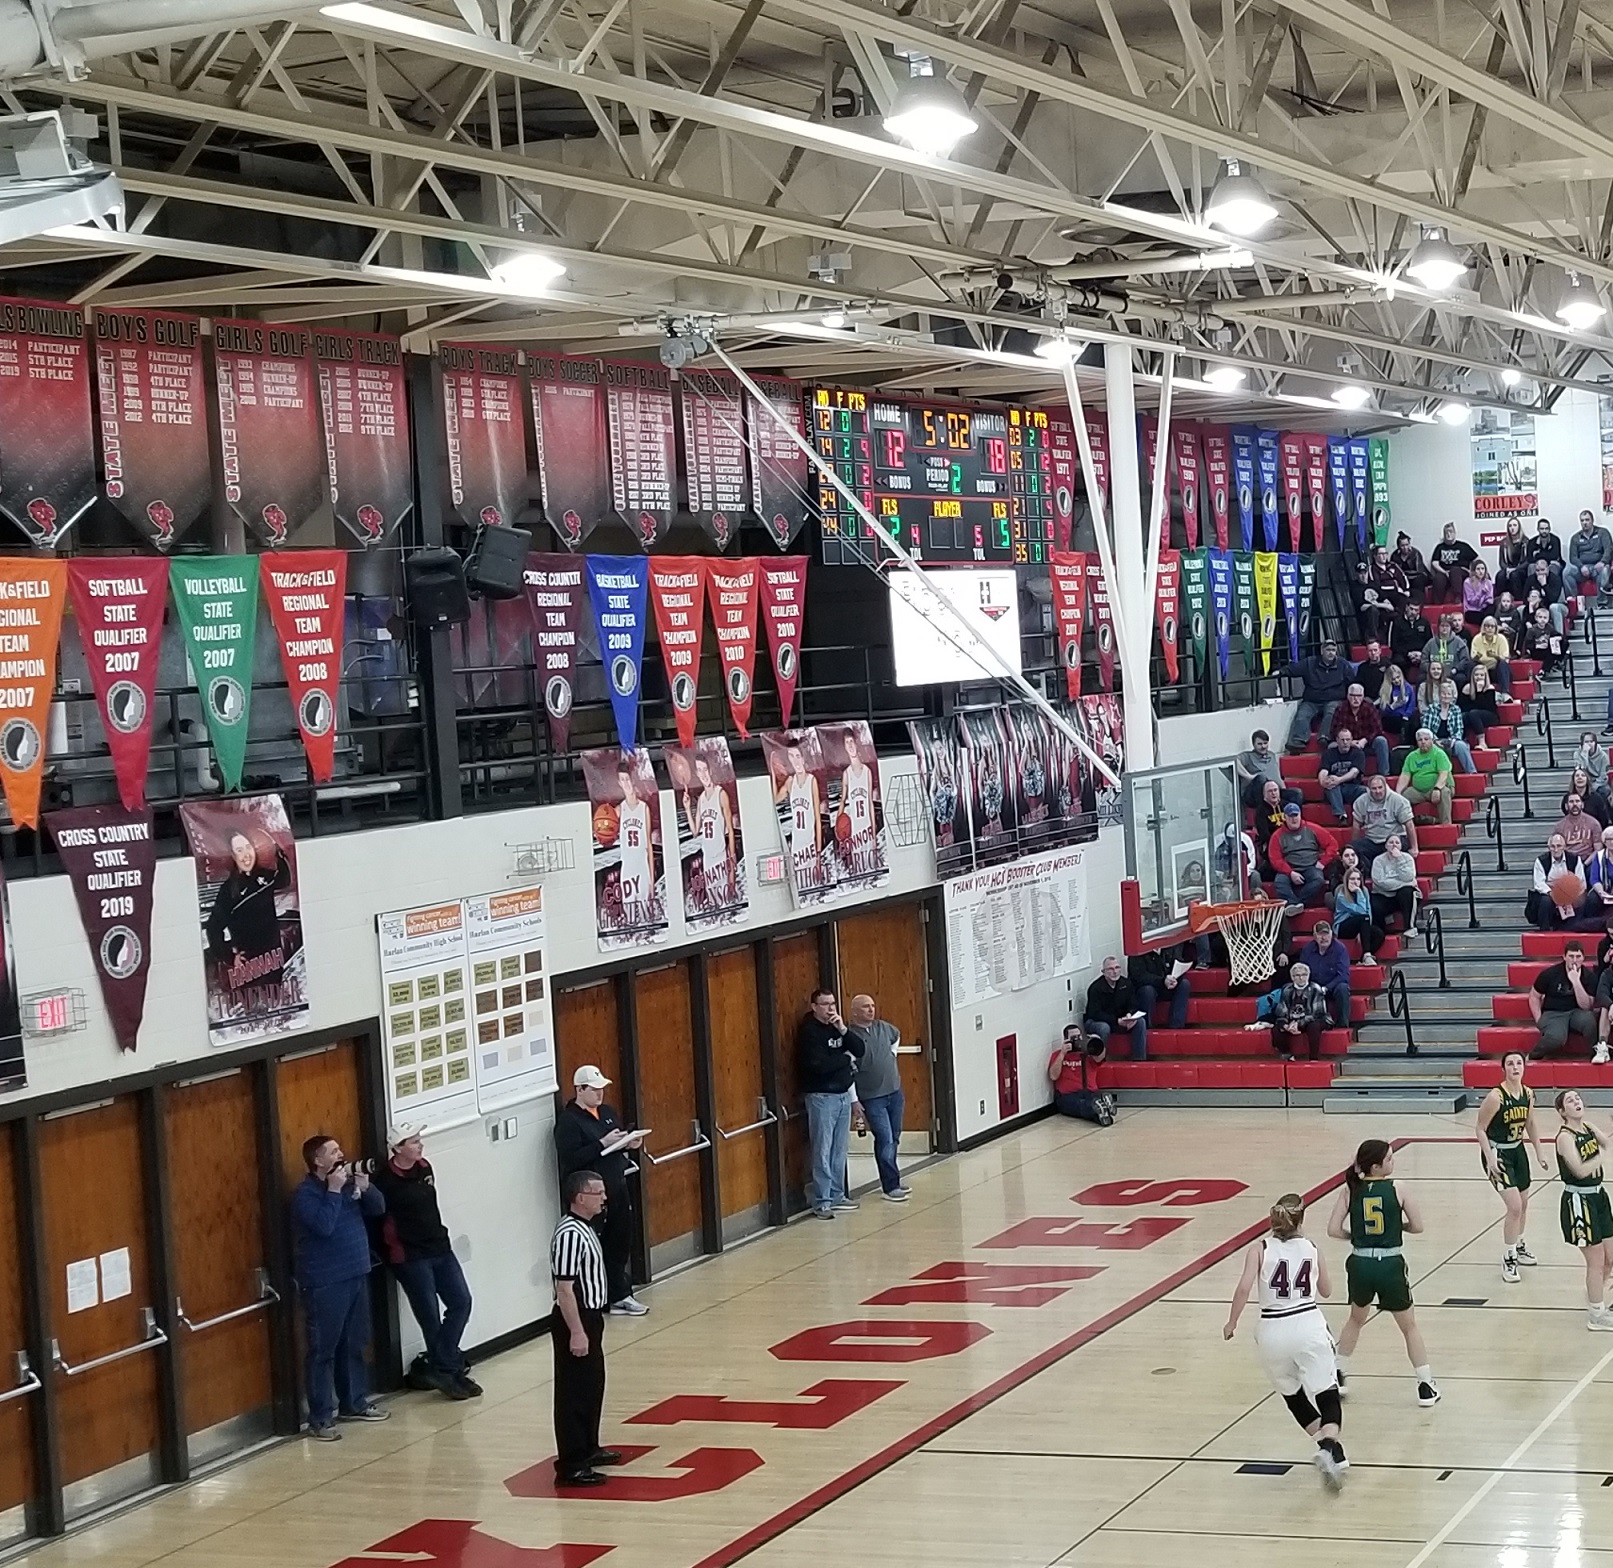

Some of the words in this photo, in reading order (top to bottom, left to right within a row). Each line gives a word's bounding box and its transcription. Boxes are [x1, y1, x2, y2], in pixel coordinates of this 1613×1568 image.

[17, 305, 84, 338] BOWLING
[97, 311, 147, 342] BOYS
[155, 318, 199, 348] GOLF
[28, 341, 80, 355] PARTICIPANT
[216, 324, 263, 354] GIRLS
[269, 329, 308, 358] GOLF
[315, 334, 353, 361] GIRLS
[357, 337, 400, 366] TRACK
[47, 356, 74, 368] PLACE
[442, 346, 474, 372] BOYS
[478, 351, 518, 376] TRACK
[47, 369, 74, 381] PLACE
[560, 359, 600, 385] SOCCER
[607, 364, 671, 391] SOFTBALL
[682, 372, 741, 396] BASEBALL
[848, 393, 866, 411] PTS
[168, 413, 192, 425] PLACE
[819, 410, 831, 431] 12
[873, 403, 901, 423] HOME
[974, 412, 1006, 432] VISITOR
[1033, 412, 1048, 429] PTS
[923, 410, 970, 449] 5:02
[1009, 427, 1022, 446] 03
[1029, 429, 1035, 447] 2
[820, 437, 833, 457] 14
[843, 437, 850, 458] 2
[886, 430, 905, 468] 12
[989, 438, 1007, 474] 18
[103, 421, 125, 499] STATE
[220, 428, 241, 503] STATE
[1011, 451, 1023, 469] 05
[862, 465, 870, 485] 2
[888, 475, 912, 490] BONUS
[925, 468, 950, 483] PERIOD
[951, 465, 961, 493] 2
[976, 480, 996, 493] BONUS
[820, 489, 836, 510] 24
[881, 498, 898, 515] FLS
[1475, 495, 1523, 510] CORLEY
[933, 501, 962, 518] PLAYER
[992, 501, 1007, 519] FLS
[1476, 510, 1506, 519] JOINED
[911, 525, 920, 546] 4
[999, 518, 1010, 547] 5
[972, 547, 986, 561] TOL
[1015, 543, 1028, 562] 35
[88, 577, 148, 598] SOFTBALL
[184, 576, 247, 596] VOLLEYBALL
[270, 570, 336, 589] TRACK&FIELD
[595, 573, 640, 589] BASKETBALL
[282, 593, 329, 613] REGIONAL
[537, 592, 573, 607] REGIONAL
[607, 595, 631, 610] STATE
[660, 593, 694, 608] REGIONAL
[776, 587, 795, 601] STATE
[104, 604, 137, 623] STATE
[203, 601, 234, 619] STATE
[545, 611, 566, 627] TEAM
[670, 611, 689, 626] TEAM
[726, 609, 743, 624] TEAM
[295, 616, 321, 634] TEAM
[601, 612, 636, 628] QUALIFIER
[94, 627, 148, 647] QUALIFIER
[193, 624, 242, 643] QUALIFIER
[538, 631, 576, 647] CHAMPION
[663, 629, 697, 645] CHAMPION
[776, 622, 796, 639] 2010
[286, 638, 334, 658] CHAMPION
[608, 634, 632, 650] 2009
[203, 648, 235, 669] 2007
[546, 652, 570, 669] 2008
[670, 650, 692, 666] 2009
[724, 645, 745, 661] 2010
[105, 652, 140, 674] 2007
[299, 663, 328, 682] 2008
[855, 799, 865, 818] 15
[57, 827, 98, 848] CROSS
[98, 822, 149, 844] COUNTRY
[627, 830, 639, 848] 55
[93, 849, 129, 868] STATE
[87, 869, 142, 892] QUALIFIER
[952, 880, 974, 898] THANK
[975, 874, 990, 892] YOU!
[1006, 865, 1035, 885] BOOSTER
[1035, 861, 1052, 877] CLUB
[1052, 853, 1083, 872] MEMBERS
[602, 874, 641, 907] CODY
[100, 896, 134, 918] 2019
[491, 902, 520, 917] winning
[406, 919, 439, 935] winning
[439, 912, 462, 928] team!
[227, 947, 285, 989] HANNAH
[39, 996, 68, 1030] EXIT
[1363, 1196, 1385, 1235] 5
[1268, 1258, 1313, 1299] 44
